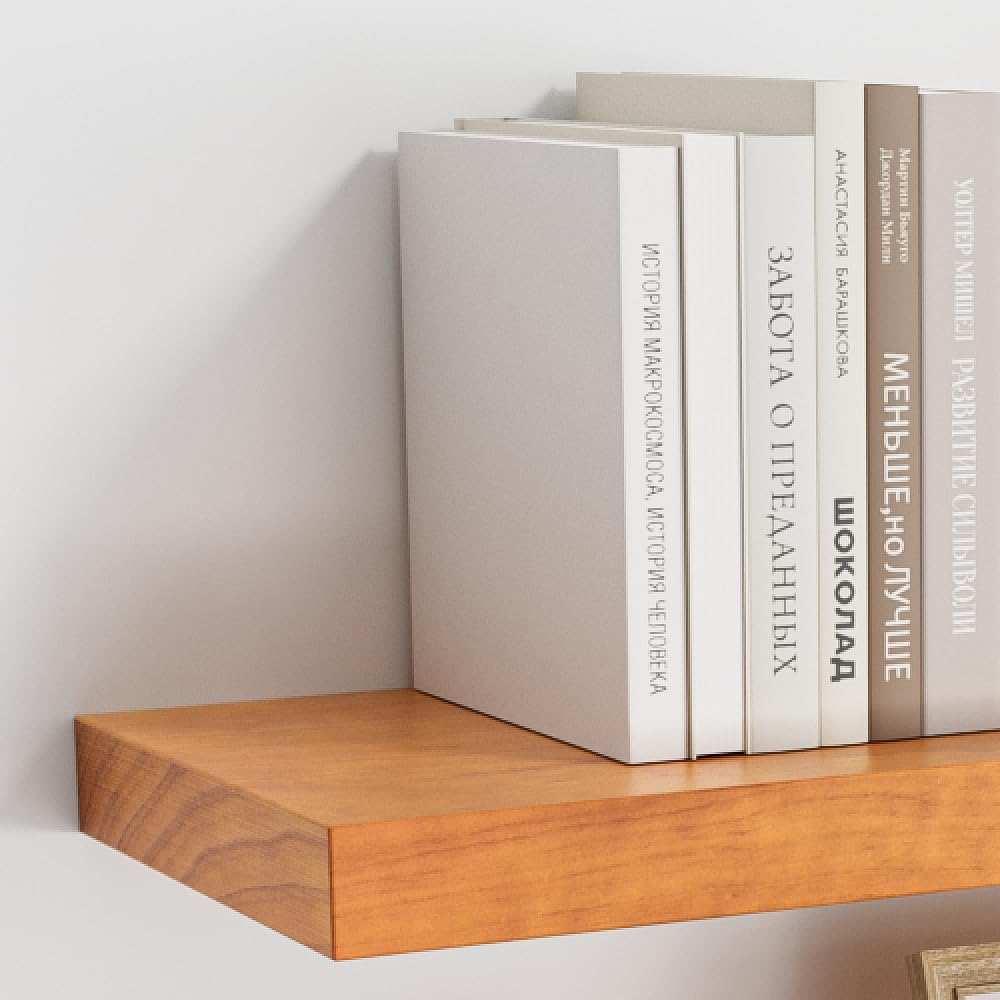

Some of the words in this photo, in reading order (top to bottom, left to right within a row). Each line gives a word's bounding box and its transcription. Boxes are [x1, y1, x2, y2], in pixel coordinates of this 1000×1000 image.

[834, 150, 848, 257] АНАСТАСИЯ
[641, 244, 662, 331] ИСТОРИЯ
[767, 246, 795, 388] ЗАБОТА
[835, 267, 849, 378] БАРАШКОВА
[953, 260, 975, 342] МИШЕЛ
[643, 337, 664, 500] МАКРОКОСМОСА,
[769, 403, 795, 429] О
[951, 357, 977, 488] РАЗВИТИЕ
[646, 507, 666, 593] ИСТОРИЯ
[766, 441, 797, 677] ПРЕДАННЫХ
[830, 497, 856, 683] ШОКОЛАД
[647, 599, 667, 696] ЧЕЛОВЕКА
[884, 562, 911, 683] ЛУЧШЕ
